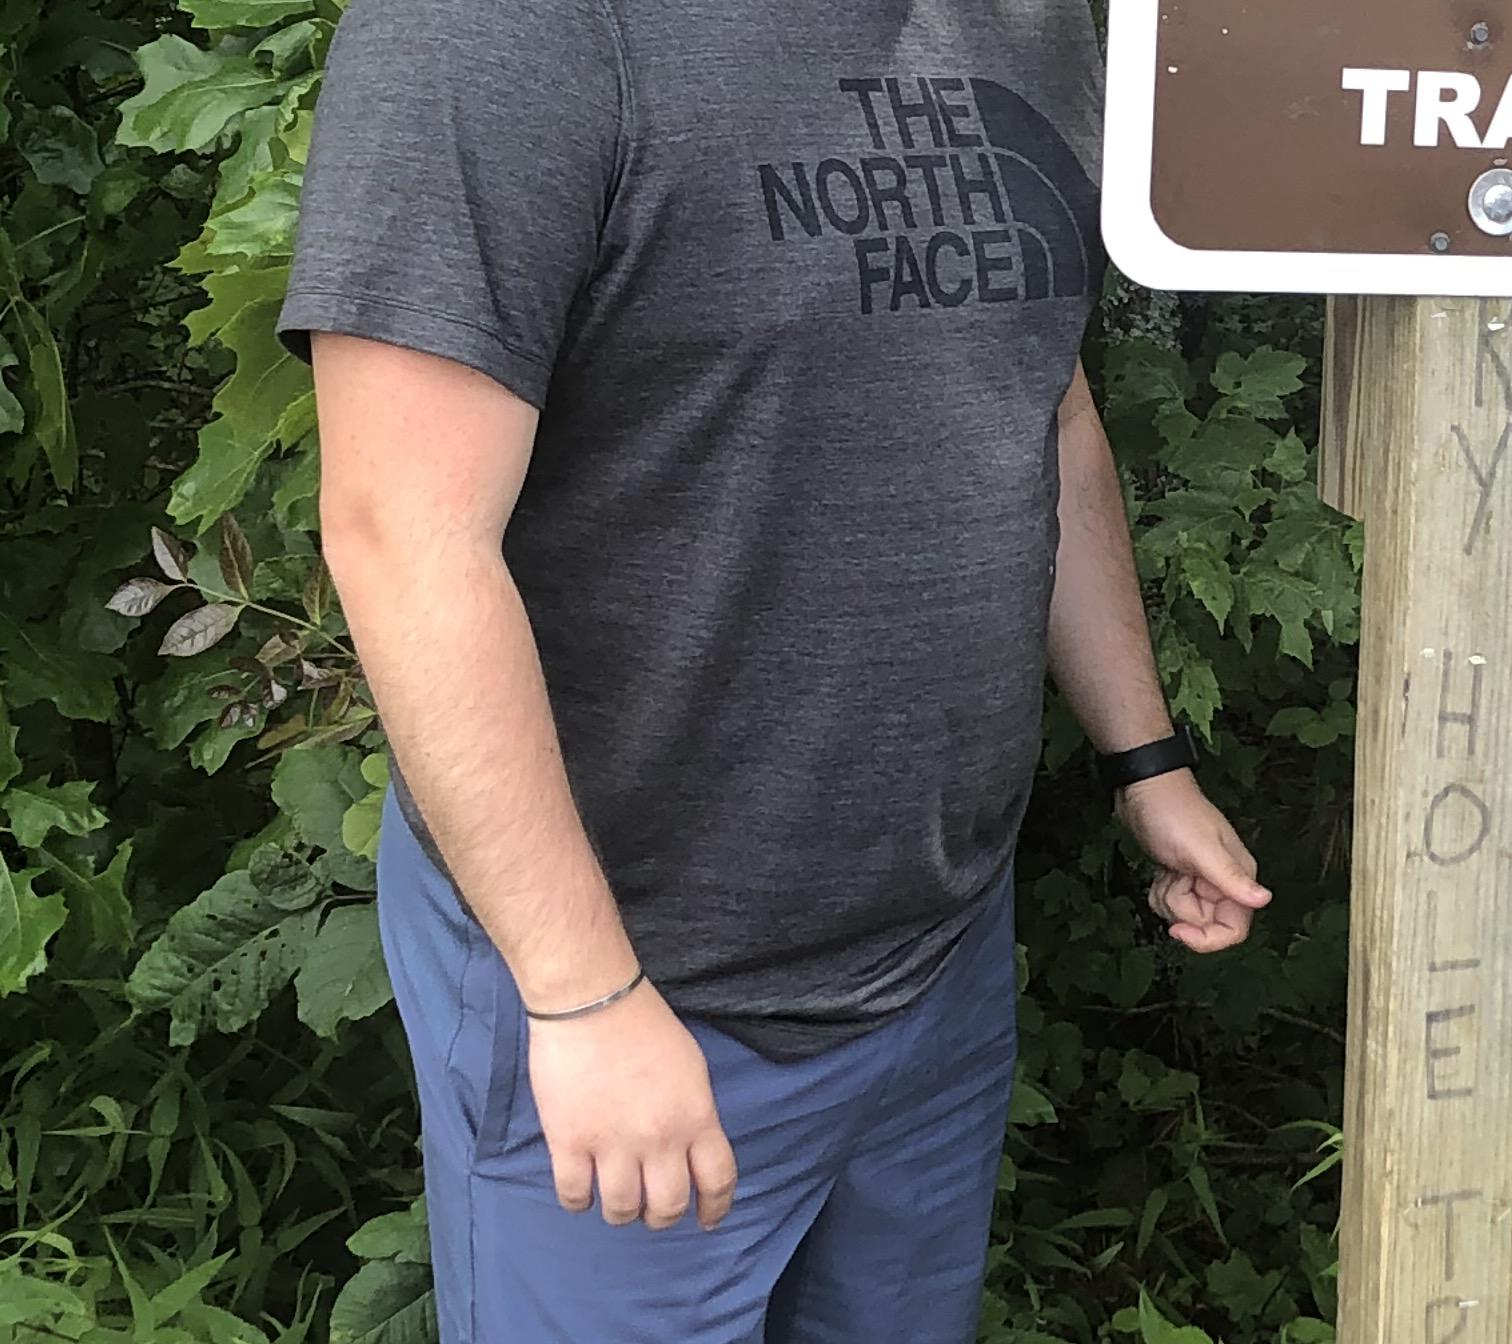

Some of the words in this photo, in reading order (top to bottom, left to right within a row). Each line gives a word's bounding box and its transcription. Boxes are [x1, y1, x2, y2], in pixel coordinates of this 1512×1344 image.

[838, 76, 984, 150] THE
[757, 153, 1008, 242] NORTH
[853, 229, 1020, 316] FACE
[1423, 648, 1491, 1100] HOLE
